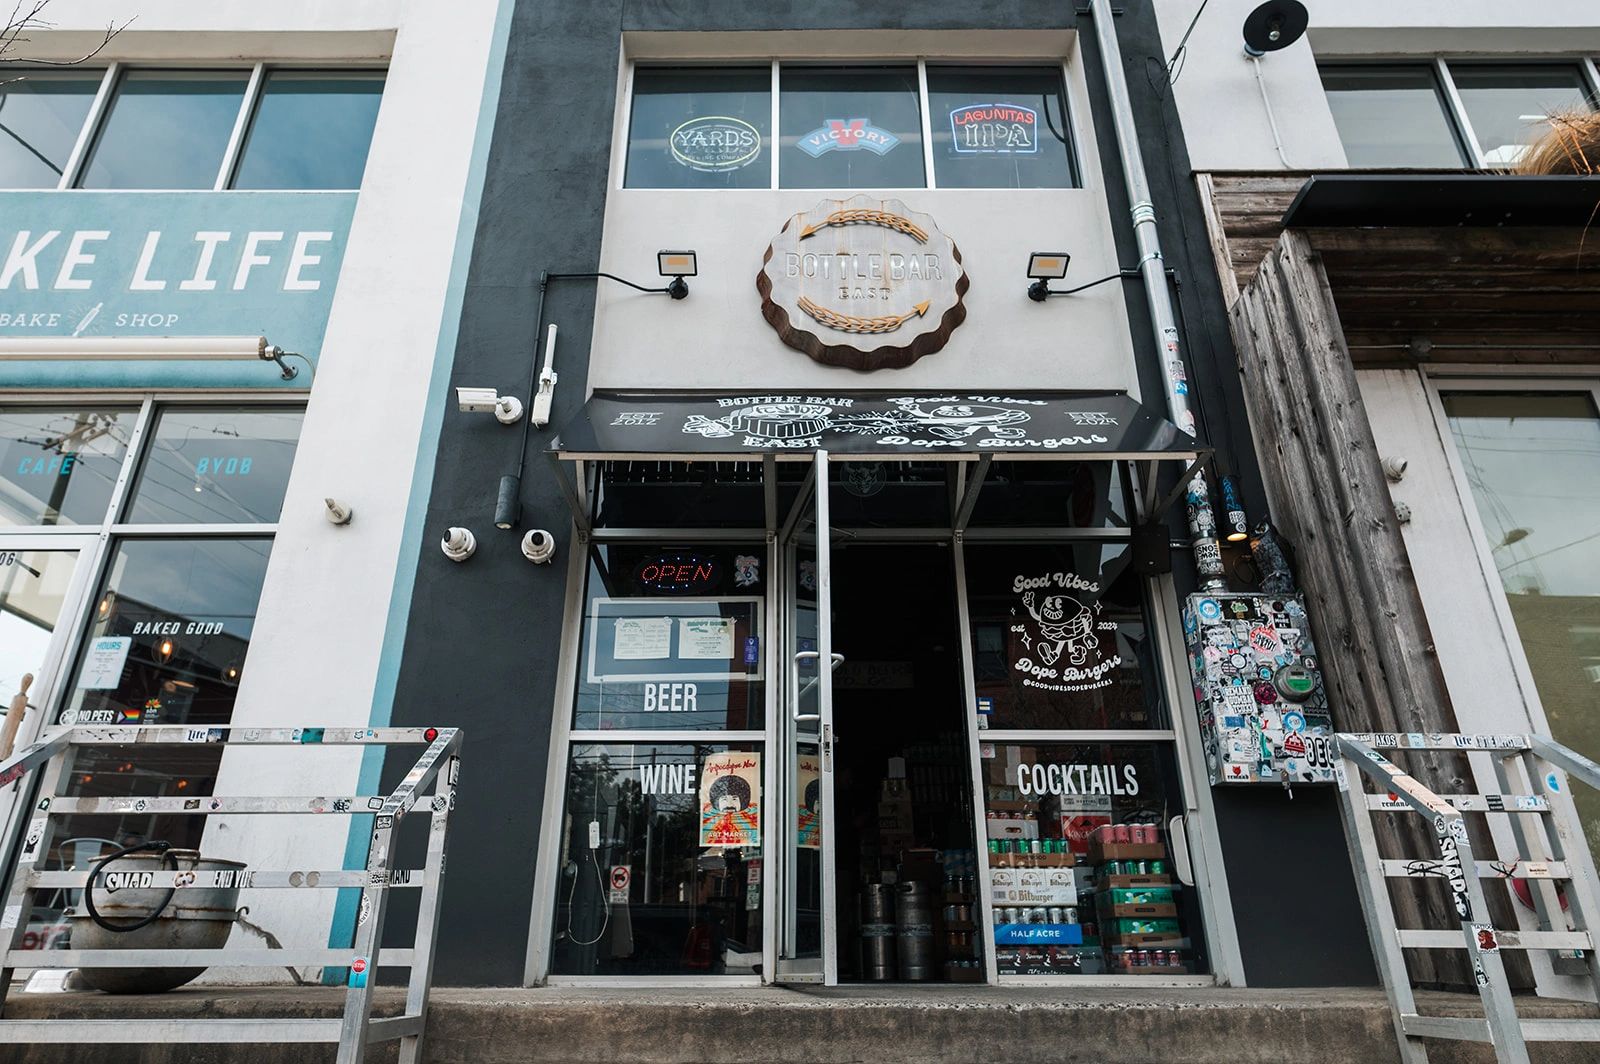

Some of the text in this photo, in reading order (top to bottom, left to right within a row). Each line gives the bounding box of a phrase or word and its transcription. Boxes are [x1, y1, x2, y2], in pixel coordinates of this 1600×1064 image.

[955, 108, 1034, 125] LAGUNITAS
[677, 130, 754, 146] YARDS
[809, 128, 890, 146] VICTORY
[964, 123, 1031, 147] IPA
[129, 230, 334, 291] LIFE
[785, 252, 943, 281] BOTTLE BAR
[838, 286, 891, 300] EAST
[0, 313, 179, 328] BAKE SHOP
[716, 395, 854, 408] BOTTLE BAR
[887, 395, 1049, 406] Good Vibes
[741, 435, 822, 448] EAST
[876, 433, 1109, 449] Dope Burgers
[641, 563, 713, 582] OPEN
[1012, 572, 1100, 593] Good Vibes
[133, 621, 224, 635] BAKED GOOD
[1010, 623, 1026, 633] est
[1097, 622, 1118, 631] 2024
[95, 641, 122, 651] HOURS
[1014, 654, 1122, 682] Dope Burgers
[643, 683, 698, 712] BEER
[79, 709, 115, 721] NO PETS
[187, 729, 206, 741] Lite
[1453, 734, 1473, 748] Lite
[640, 764, 697, 795] WINE
[1016, 763, 1140, 796] COCKTAILS
[1018, 889, 1054, 903] Bitburger
[1010, 929, 1061, 938] HALF ACRE
